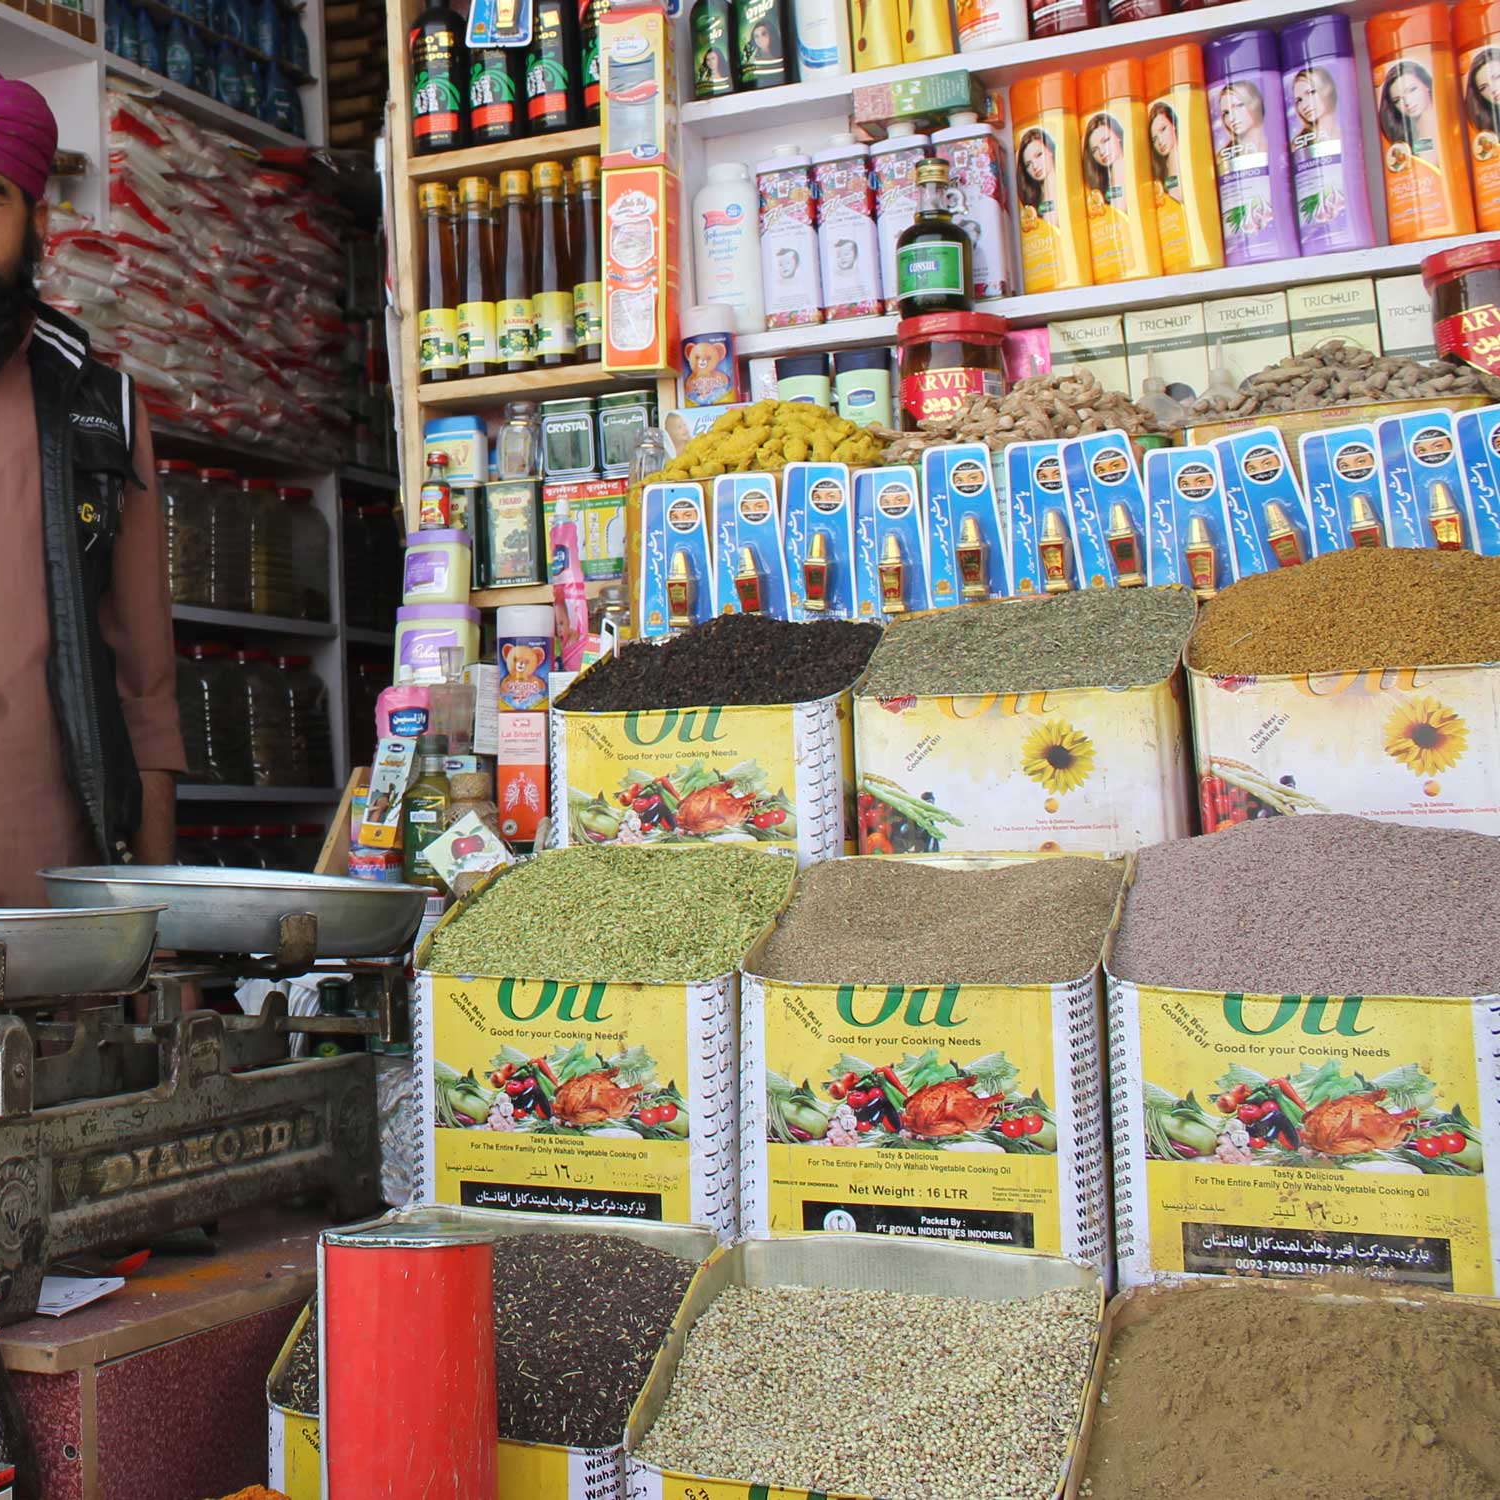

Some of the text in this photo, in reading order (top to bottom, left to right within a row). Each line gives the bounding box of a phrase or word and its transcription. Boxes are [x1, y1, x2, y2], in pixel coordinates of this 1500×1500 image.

[909, 260, 937, 273] CONSUL
[1301, 290, 1360, 309] TRICHUP
[1217, 303, 1274, 322] TRICHUP
[1387, 302, 1432, 318] TRICHU
[1138, 314, 1192, 332] TRICHUP
[1060, 324, 1110, 342] TRICHUP
[546, 420, 589, 434] CRYSTAL
[603, 415, 643, 426] کریستال
[590, 724, 614, 749] The Best
[1249, 712, 1279, 744] The Best
[1250, 713, 1290, 755] Cooking Oil
[617, 749, 710, 762] Good for your Cooking
[905, 733, 932, 763] The Best
[906, 744, 932, 773] Cooking
[460, 992, 487, 1022] The Best
[497, 977, 613, 1023] Oil
[836, 984, 968, 1028] Oil
[449, 993, 487, 1033] Cooking Oil
[783, 996, 823, 1040] Cooking Oil
[795, 996, 823, 1028] The Best
[1174, 1001, 1209, 1037] The Best
[1223, 992, 1375, 1036] Oil
[490, 1027, 623, 1041] Good for your Cooking Needs
[1160, 1003, 1210, 1049] Cooking Oil
[827, 1034, 981, 1047] Good for your Cooking Needs
[1214, 1043, 1390, 1058] Good for your Cooking Needs
[530, 1136, 584, 1146] Tasty & Delicious
[495, 1144, 514, 1152] Entire
[515, 1145, 536, 1154] Family
[537, 1146, 552, 1155] Only
[553, 1147, 575, 1155] Wahab
[576, 1148, 608, 1158] Vegetable
[609, 1150, 638, 1160] Cooking
[638, 1151, 648, 1159] Oil
[876, 1151, 939, 1162] Tasty Delicious
[807, 1158, 1012, 1176] For The Entire Family Only Wahab Vegetable Cooking Oil
[1273, 1169, 1344, 1182] Tasty Delicious
[573, 1173, 595, 1184] وزن
[1195, 1175, 1430, 1198] For The Entire Family Only Wahab Vegetable Cooking Oil
[475, 1190, 511, 1205] افغانستان
[509, 1192, 529, 1208] کابل
[849, 1184, 968, 1200] Net Weight 16 LTR
[550, 1196, 575, 1212] وهاب
[575, 1196, 591, 1212] فقیر
[591, 1199, 616, 1211] شرکت
[920, 1215, 961, 1228] Packed By
[876, 1224, 1013, 1240] PT. ROYAL INDUSTRIES INDONESIA
[1202, 1235, 1248, 1250] افغانستان
[1247, 1237, 1273, 1255] کابل
[1300, 1242, 1333, 1260] وهاب
[1334, 1242, 1354, 1259] فقیر
[1355, 1243, 1390, 1262] شرکت
[301, 1428, 321, 1453] Cook
[584, 1465, 621, 1486] Wahab
[584, 1479, 621, 1500] Wahab
